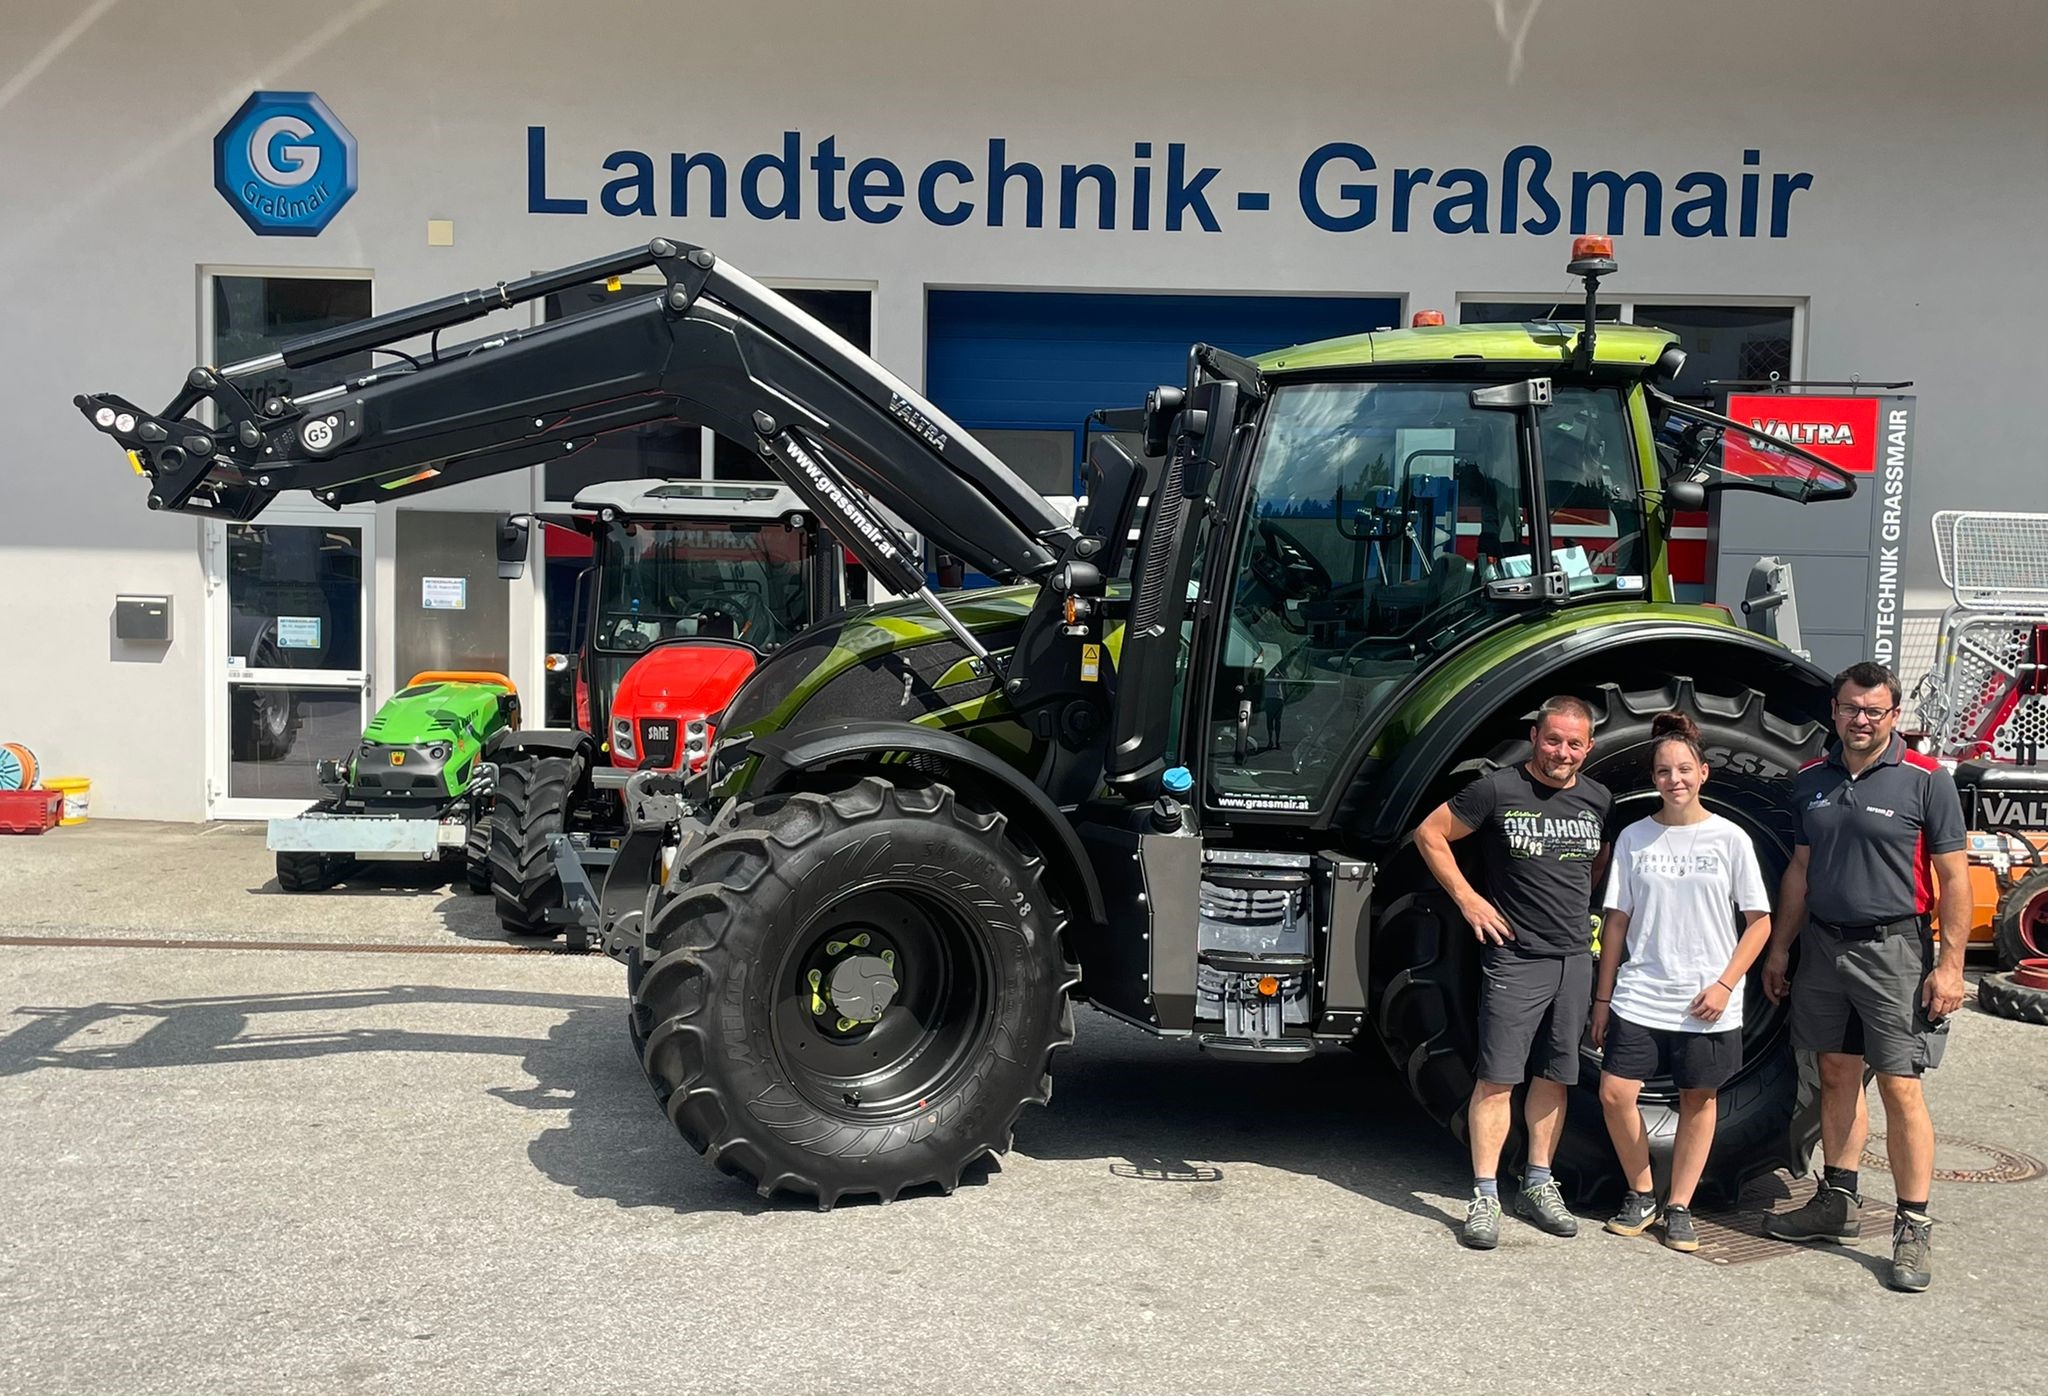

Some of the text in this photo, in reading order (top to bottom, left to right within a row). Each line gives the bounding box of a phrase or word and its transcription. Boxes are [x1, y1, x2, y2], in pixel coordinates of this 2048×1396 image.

[251, 115, 321, 187] G
[241, 180, 331, 219] Graßmair
[1299, 142, 1814, 238] Graßmair
[308, 425, 328, 443] G5
[889, 391, 948, 452] VALTRA
[1750, 418, 1854, 447] VALTRA
[786, 441, 897, 559] www.grassmair.at
[1874, 409, 1908, 670] NDTECHNIK GRASSMAIR
[648, 726, 669, 740] SAME
[1218, 798, 1309, 811] www.grassmair.at
[1638, 854, 1694, 864] VERTICAL
